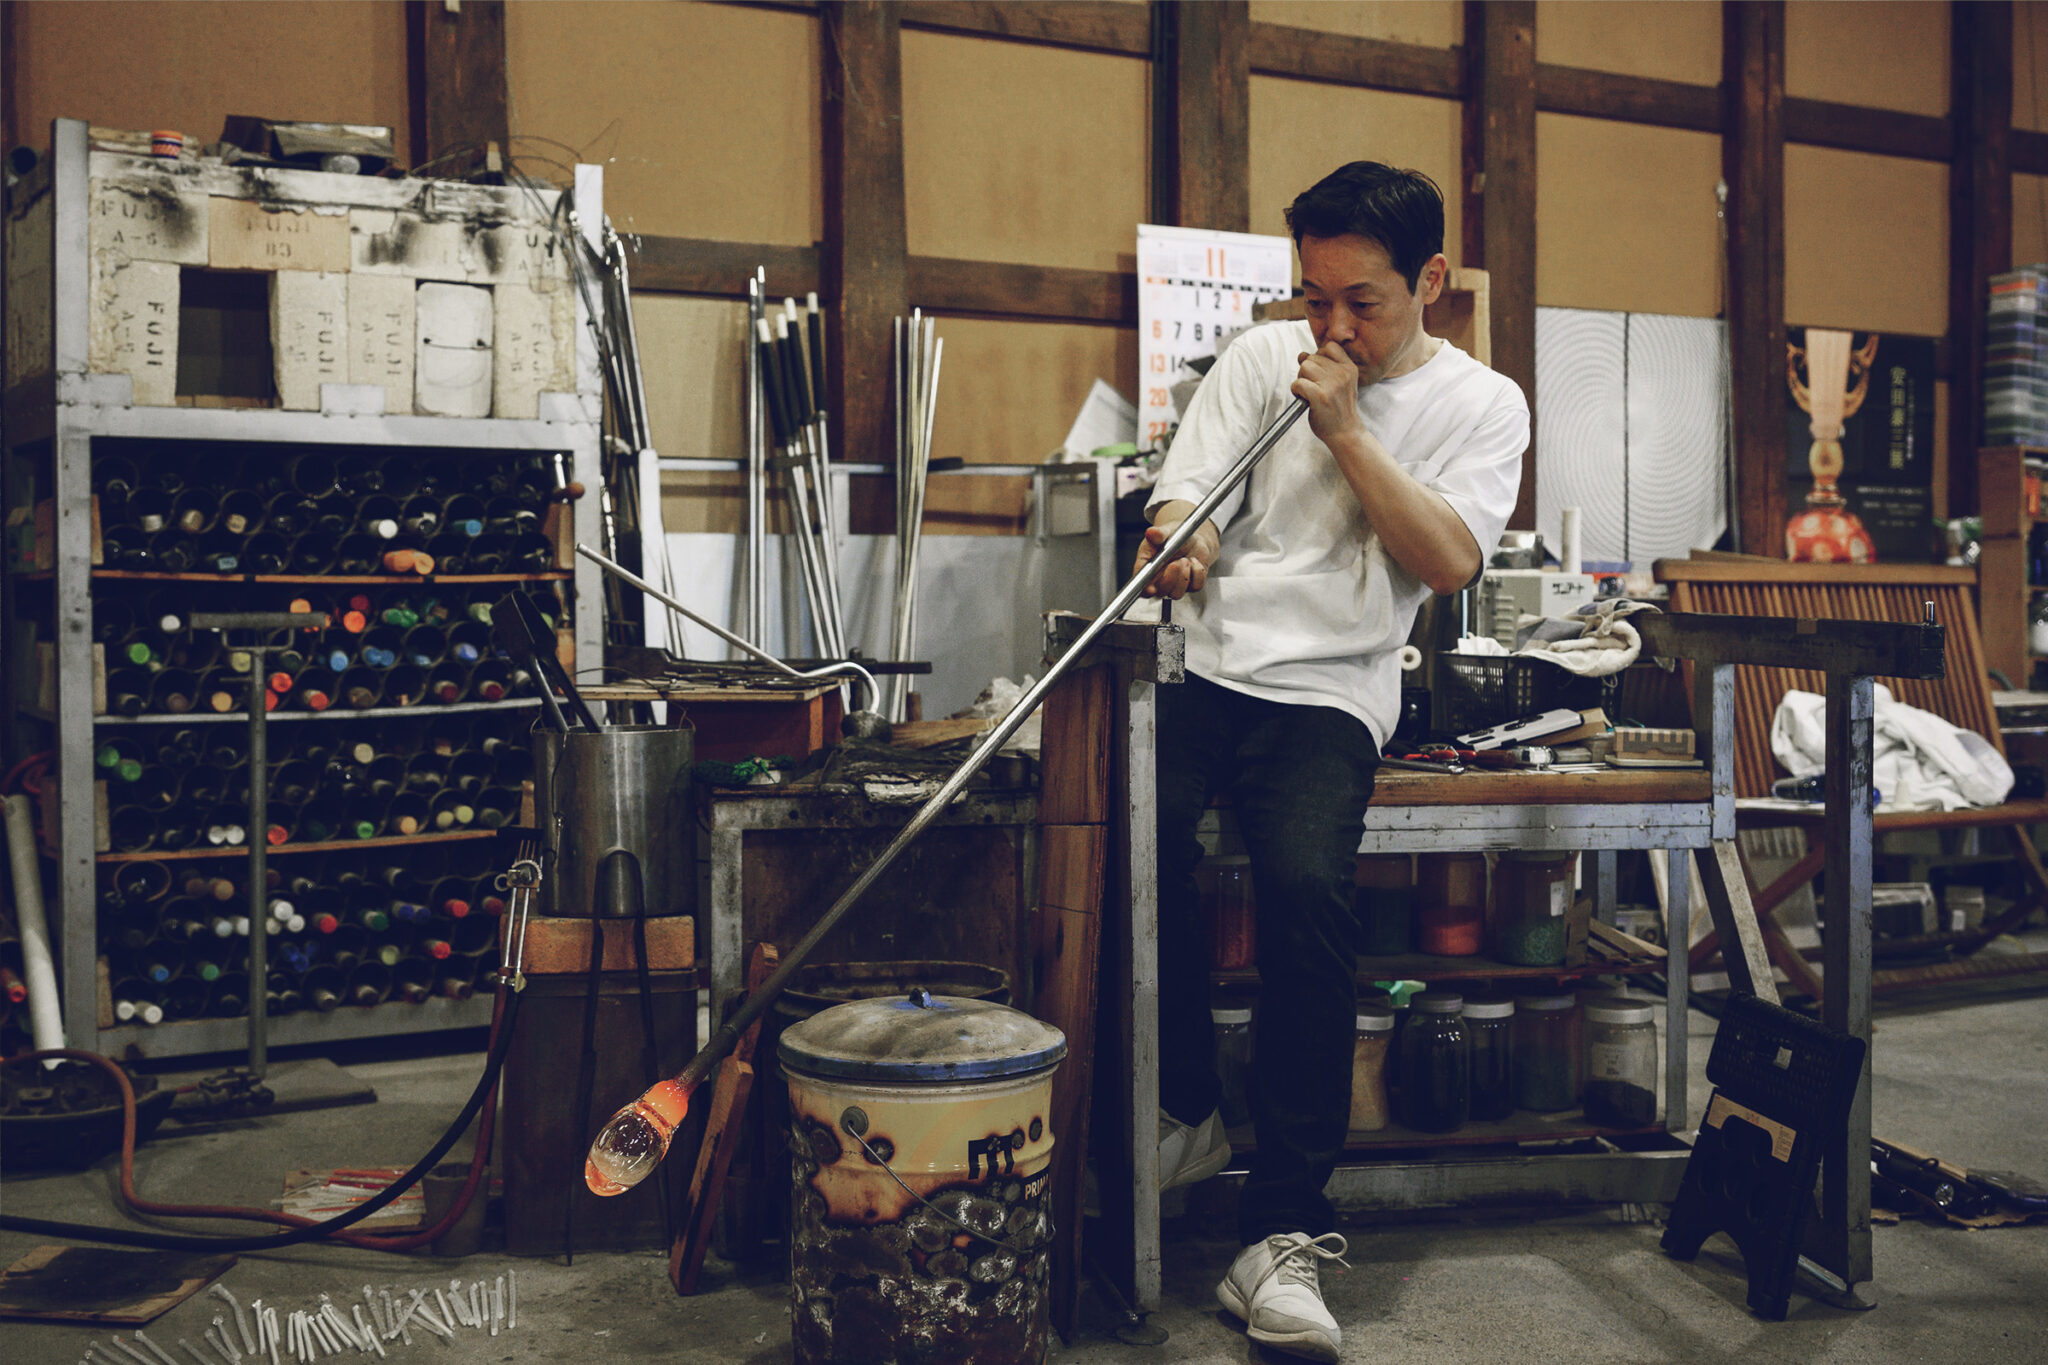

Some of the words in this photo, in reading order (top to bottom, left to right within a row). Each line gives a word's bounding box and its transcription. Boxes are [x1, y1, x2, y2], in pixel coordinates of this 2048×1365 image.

[1206, 247, 1226, 279] 11
[1213, 290, 1222, 310] 2
[1232, 291, 1241, 313] 3
[147, 301, 165, 366] FUJI
[318, 311, 335, 374] FUJI
[386, 312, 402, 376] FUJI
[1152, 319, 1162, 340] 6
[1173, 320, 1182, 340] 7
[1194, 322, 1203, 342] 8
[1149, 353, 1166, 374] 13
[1149, 387, 1168, 408] 20
